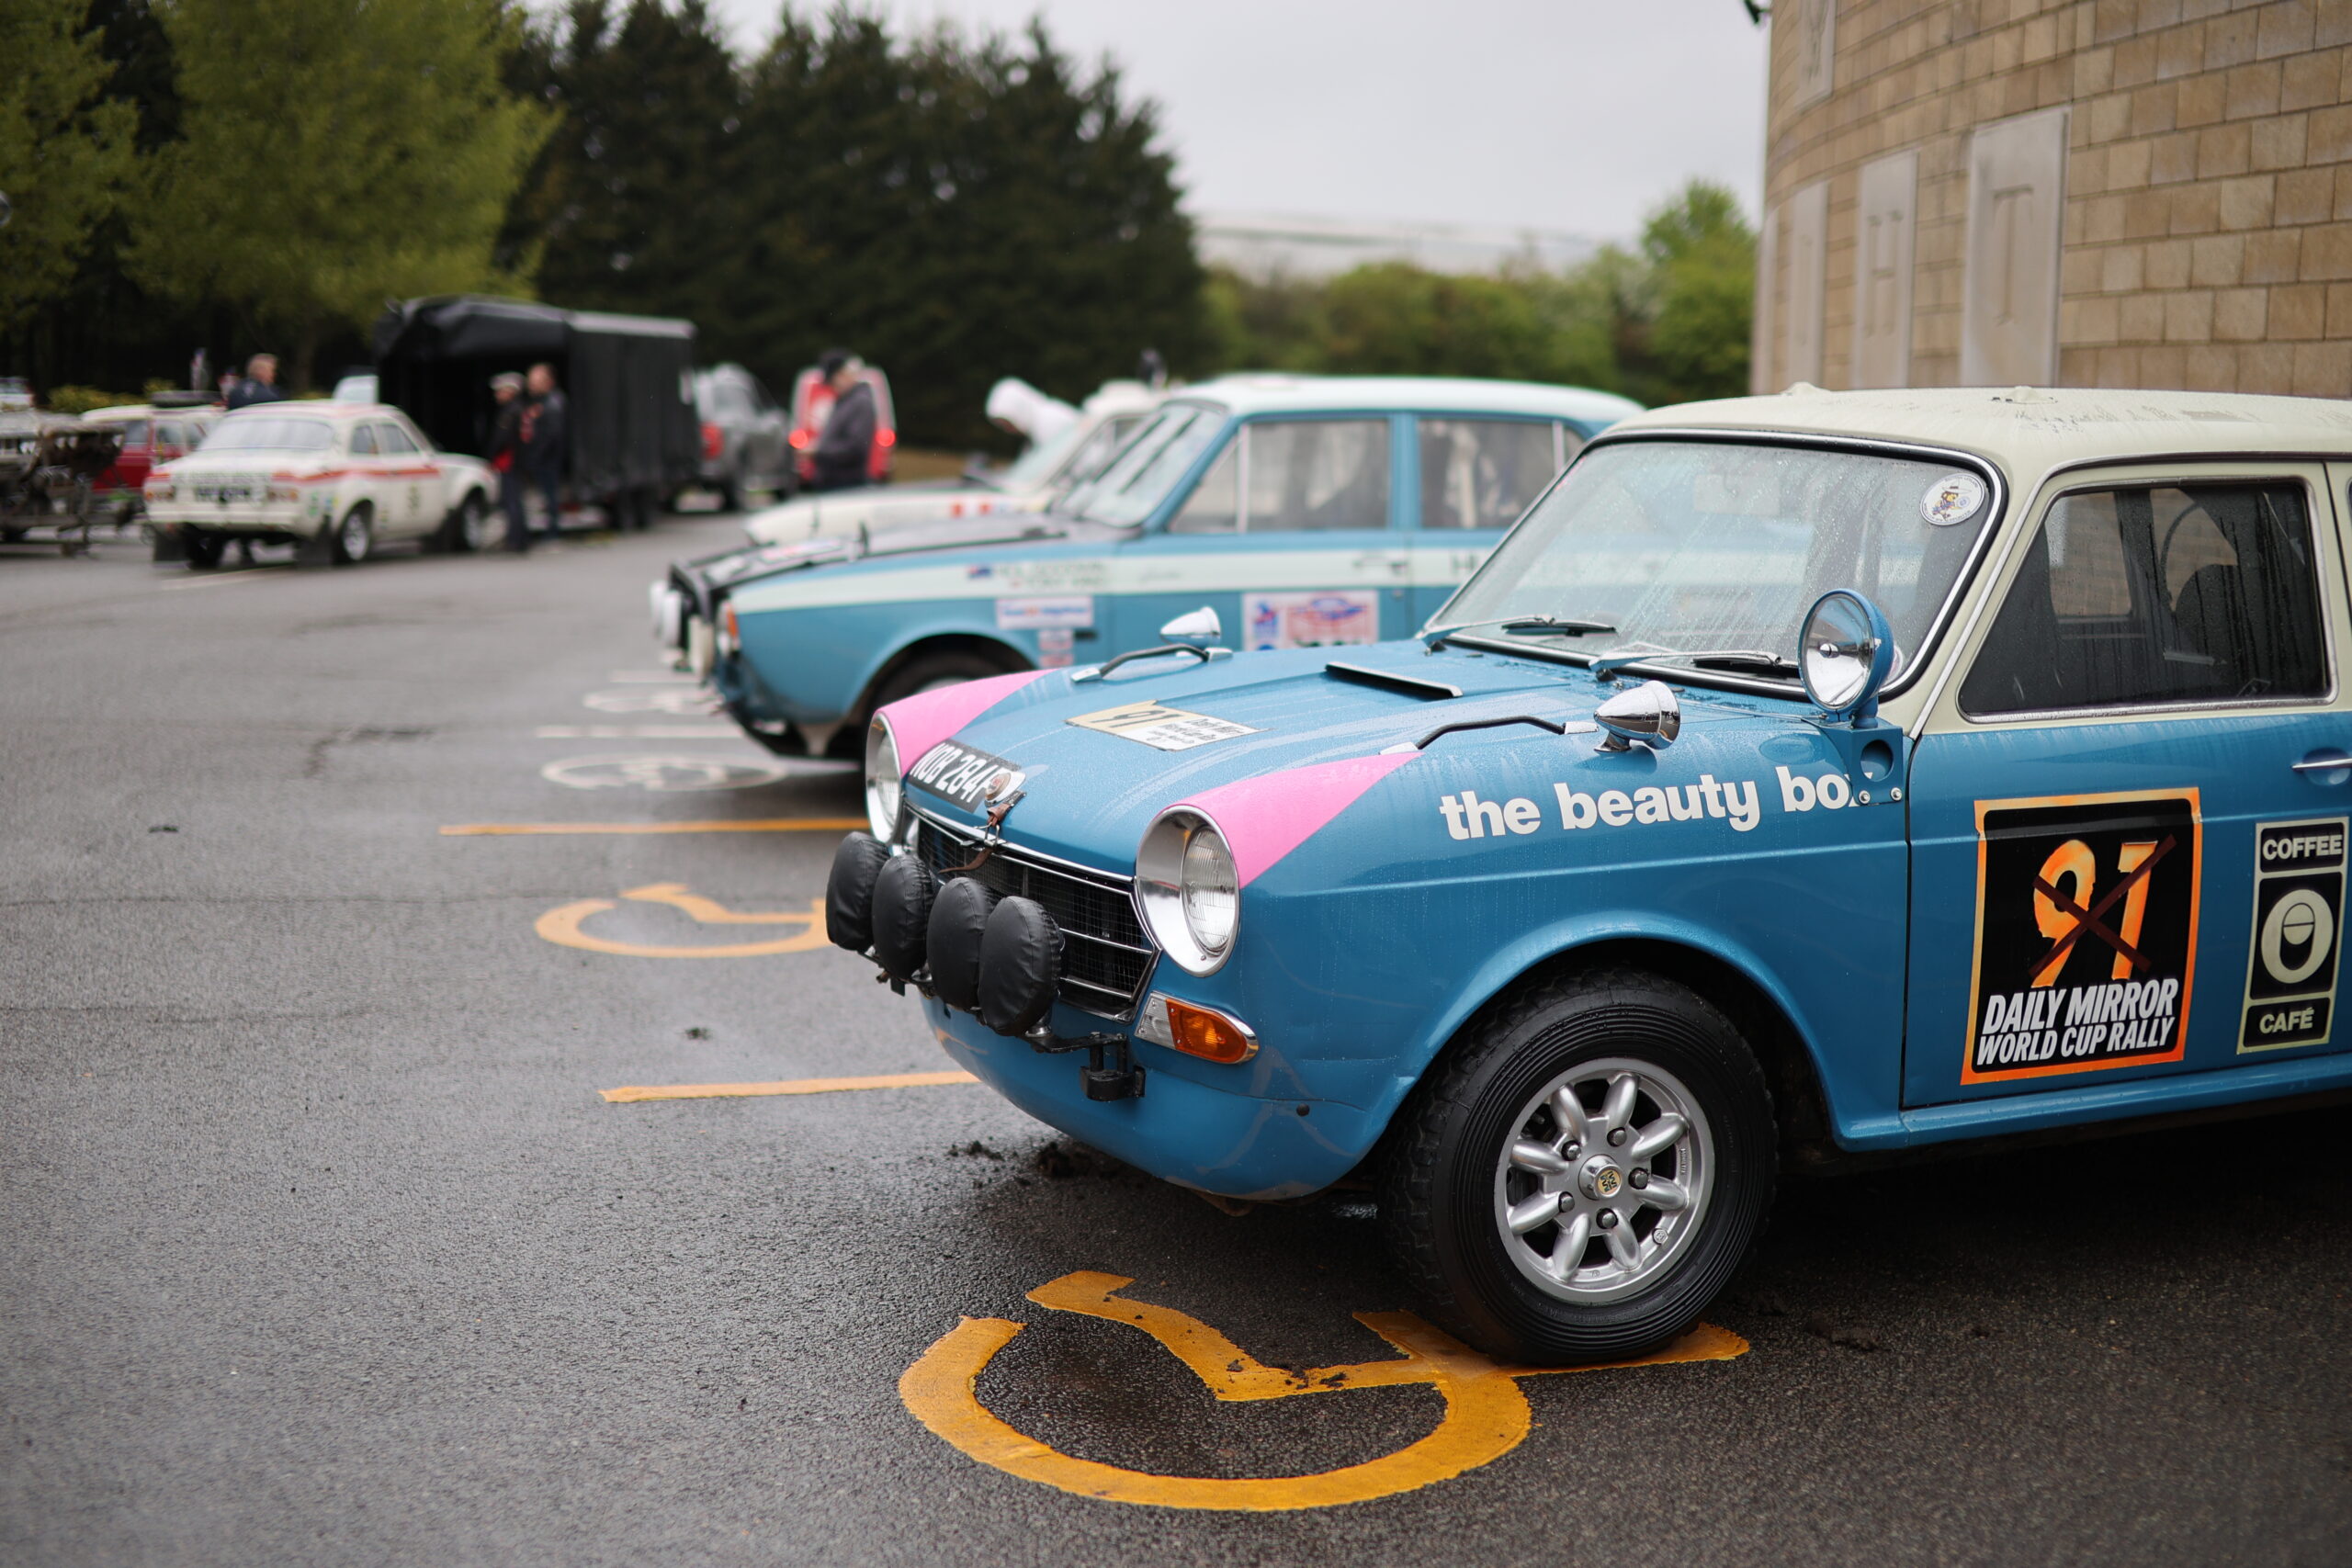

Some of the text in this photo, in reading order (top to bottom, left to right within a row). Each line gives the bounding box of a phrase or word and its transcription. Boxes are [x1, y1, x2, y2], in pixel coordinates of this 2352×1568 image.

[1439, 789, 1542, 840] the
[1554, 774, 1761, 833] beauty
[2262, 834, 2343, 861] COFFEE
[2030, 839, 2159, 989] 91
[1982, 978, 2178, 1034] DAILY MIRROR
[2259, 1007, 2315, 1034] CAFÉ
[1976, 1016, 2176, 1066] WORLD CUP RALLY
